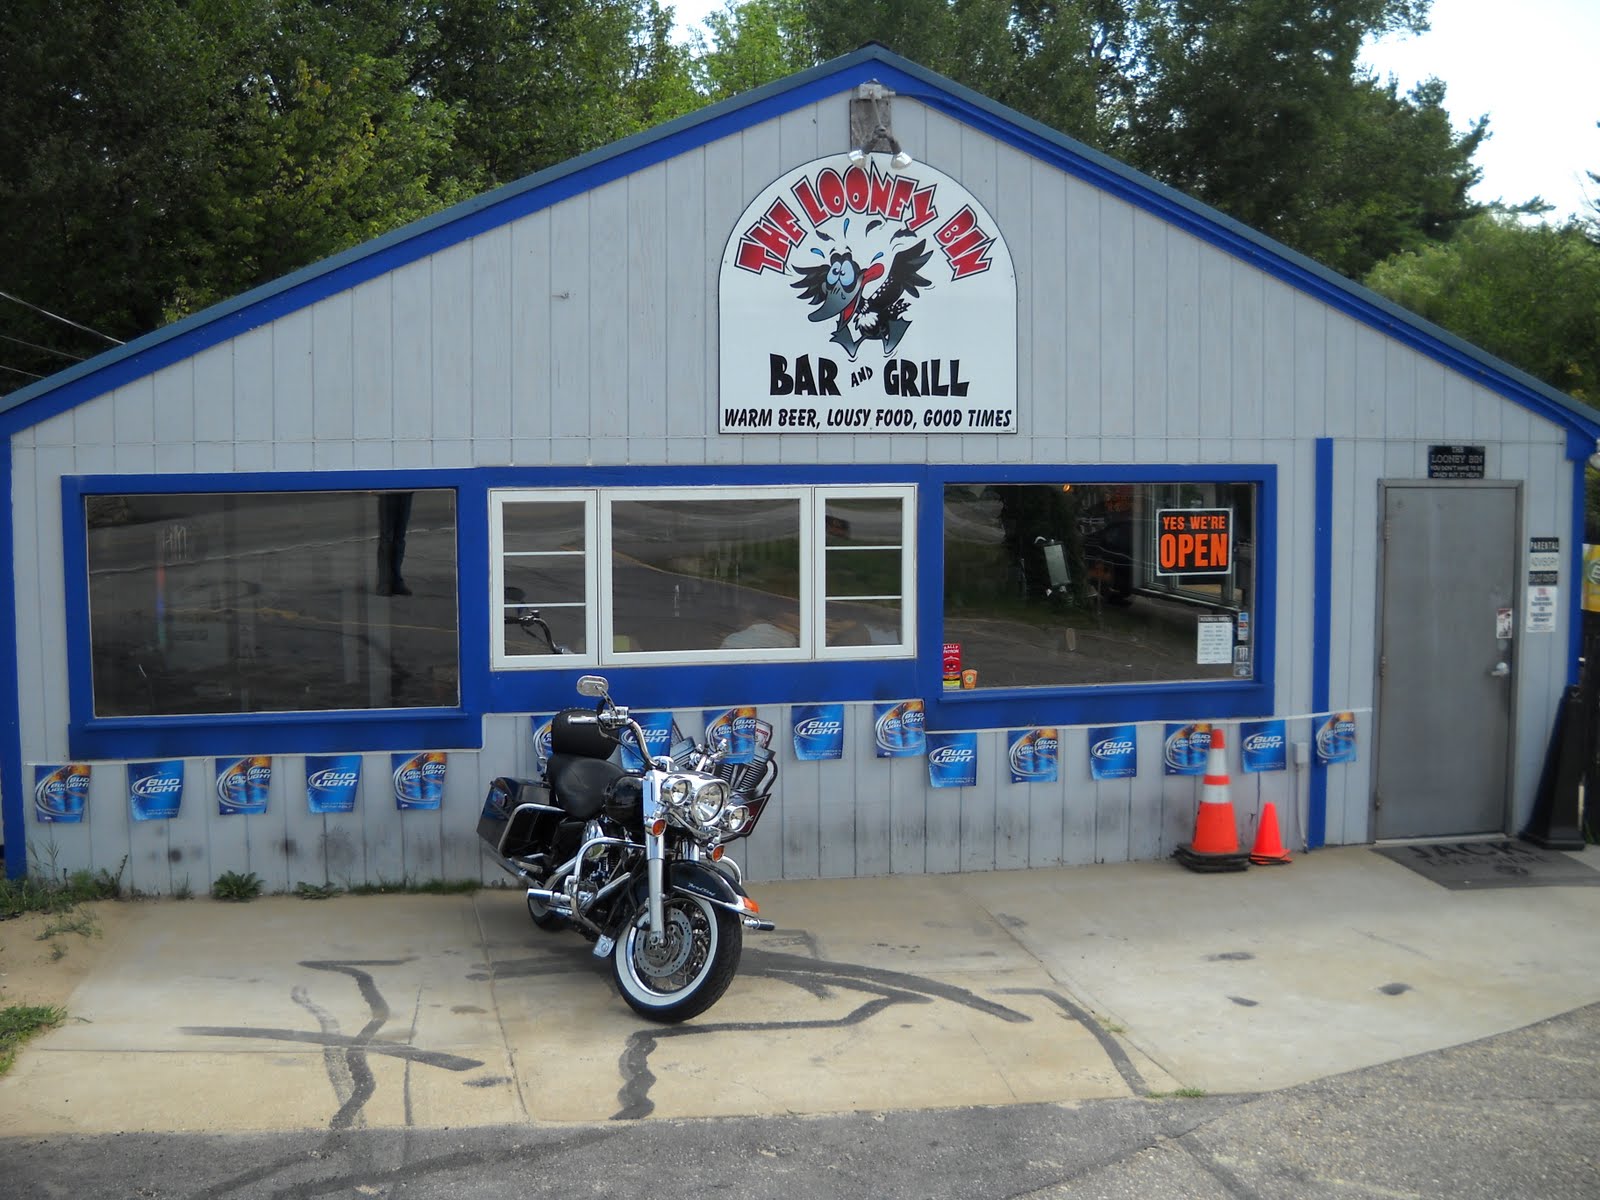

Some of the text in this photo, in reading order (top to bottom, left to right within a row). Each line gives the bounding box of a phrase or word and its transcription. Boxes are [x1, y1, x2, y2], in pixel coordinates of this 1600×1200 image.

[734, 158, 997, 281] THE LOONEY BIN
[769, 353, 970, 397] BAR AND GRILL
[725, 408, 1012, 430] WARM BEER, LOUSY FOOD, GOOD TIMES
[1431, 454, 1483, 464] LOONEY BIN
[1163, 515, 1226, 530] YES WE'RE
[1161, 533, 1228, 568] OPEN
[1530, 541, 1559, 550] PARENTAL
[1247, 742, 1284, 750] LIGHT
[322, 772, 356, 780] BUD
[146, 778, 180, 786] BUD
[139, 785, 182, 794] LIGHT
